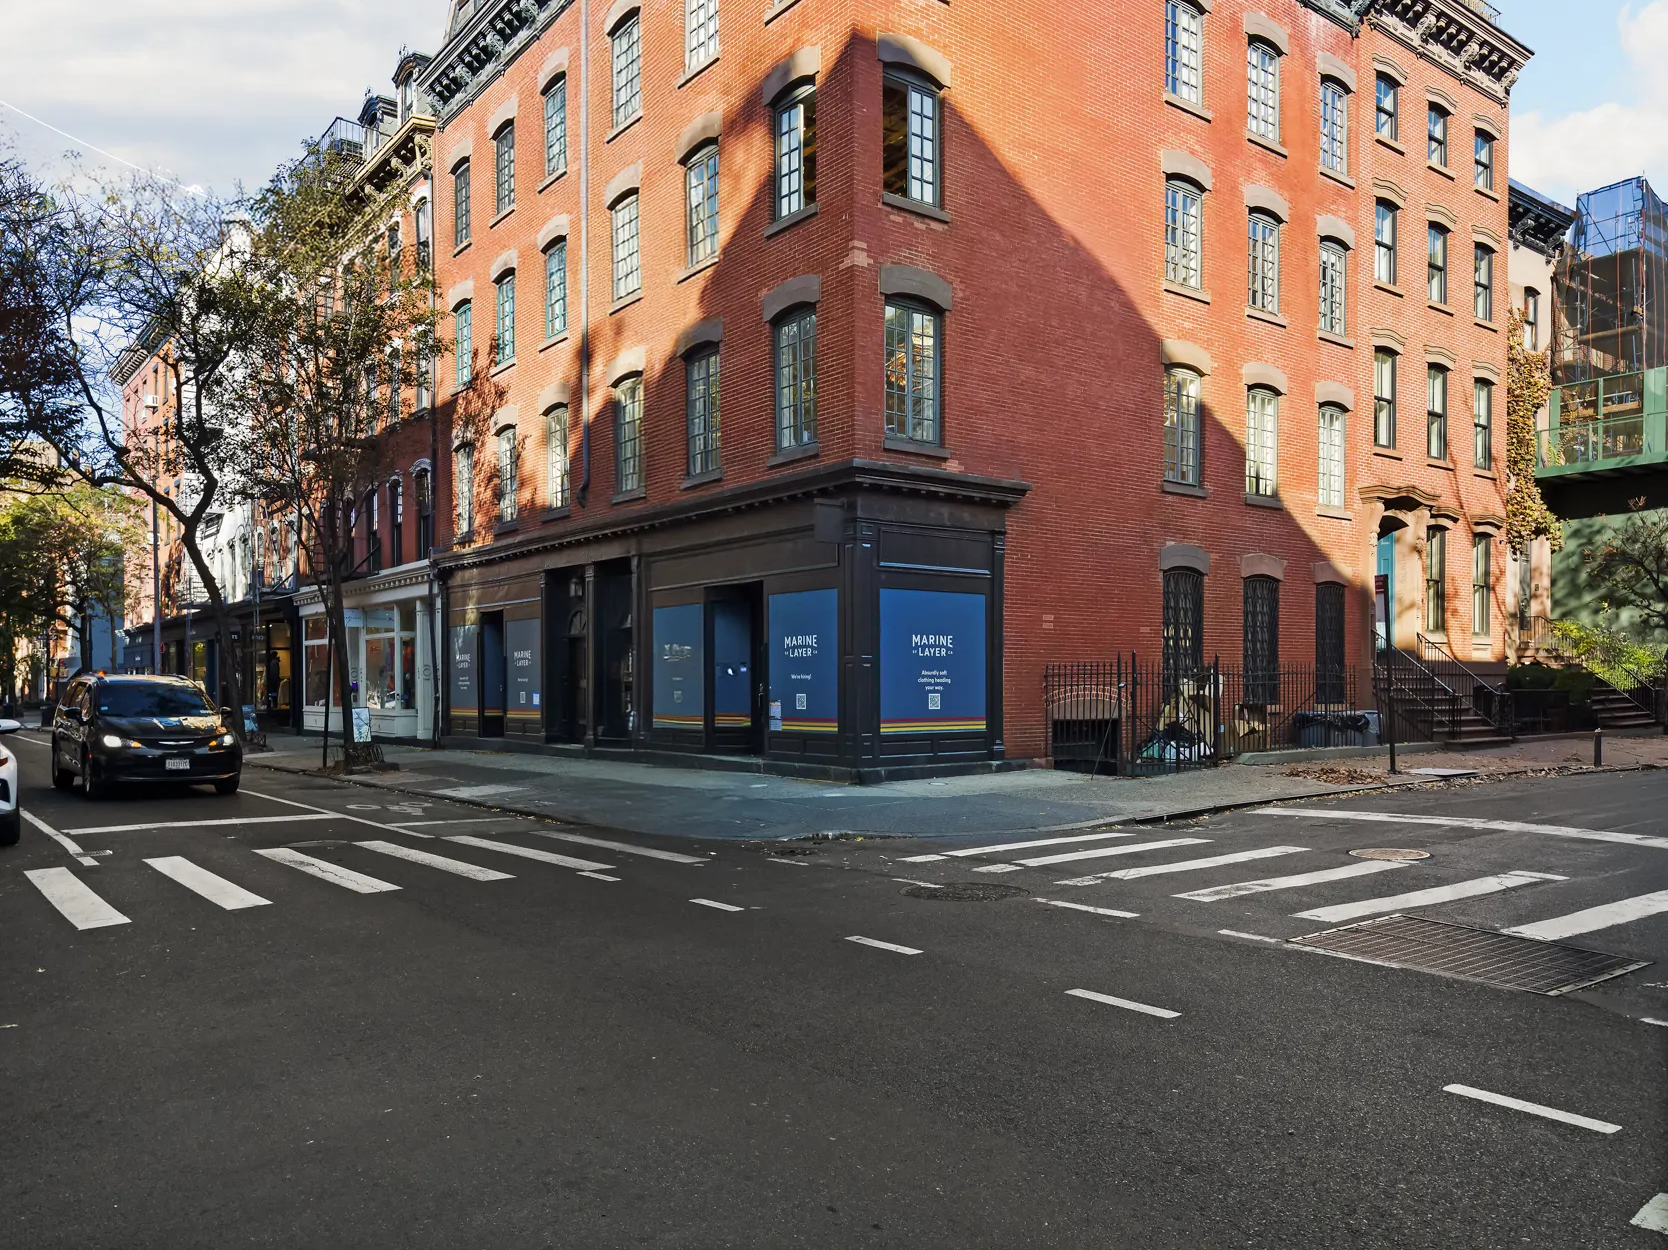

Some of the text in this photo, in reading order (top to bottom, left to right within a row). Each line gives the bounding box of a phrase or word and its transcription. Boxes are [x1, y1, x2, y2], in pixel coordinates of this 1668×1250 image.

[784, 634, 818, 648] MARINE
[912, 634, 953, 647] MARINE
[513, 650, 531, 660] MARINE
[790, 648, 812, 657] LAYER
[918, 647, 946, 656] LAYER
[455, 653, 471, 662] MARINE
